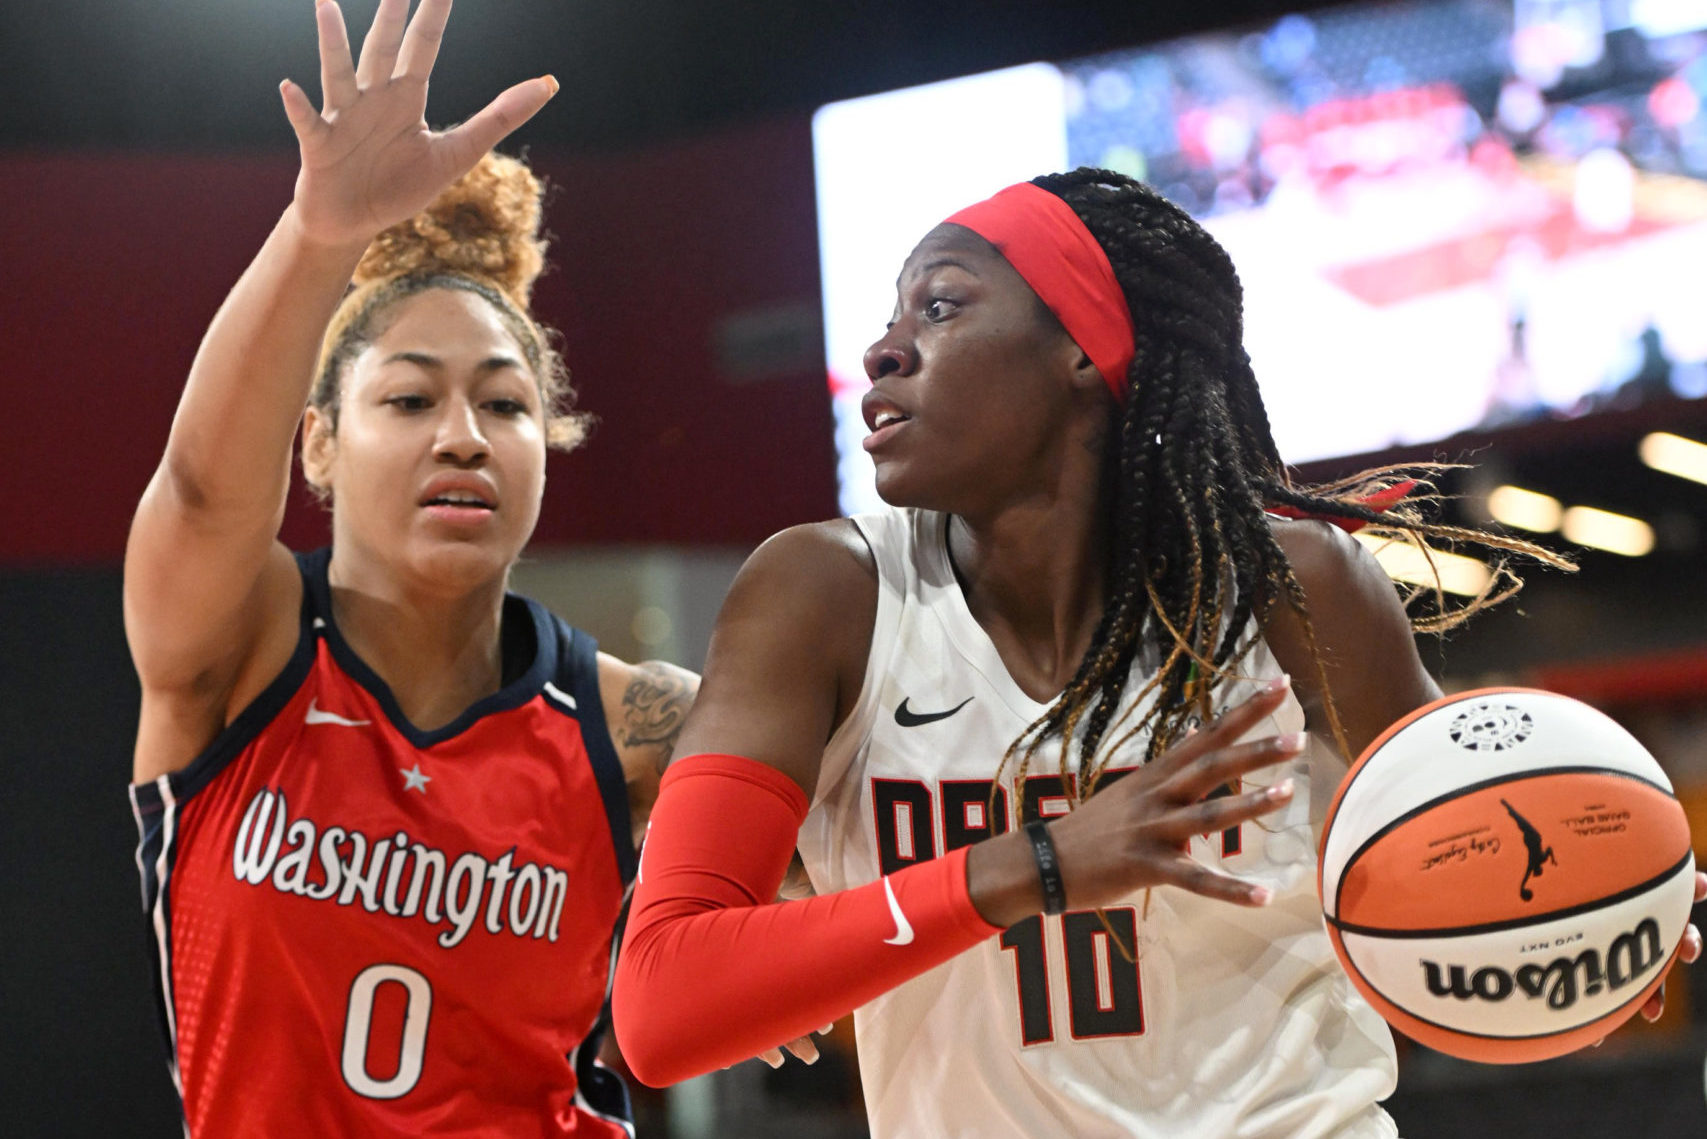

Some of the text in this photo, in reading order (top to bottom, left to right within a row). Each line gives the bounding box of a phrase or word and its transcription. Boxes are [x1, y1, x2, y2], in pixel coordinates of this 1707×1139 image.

[1573, 823, 1626, 836] OFFICIAL
[1000, 906, 1146, 1048] 10
[1420, 917, 1664, 1010] Wilson
[1520, 942, 1549, 953] NXT
[341, 963, 432, 1100] 0
